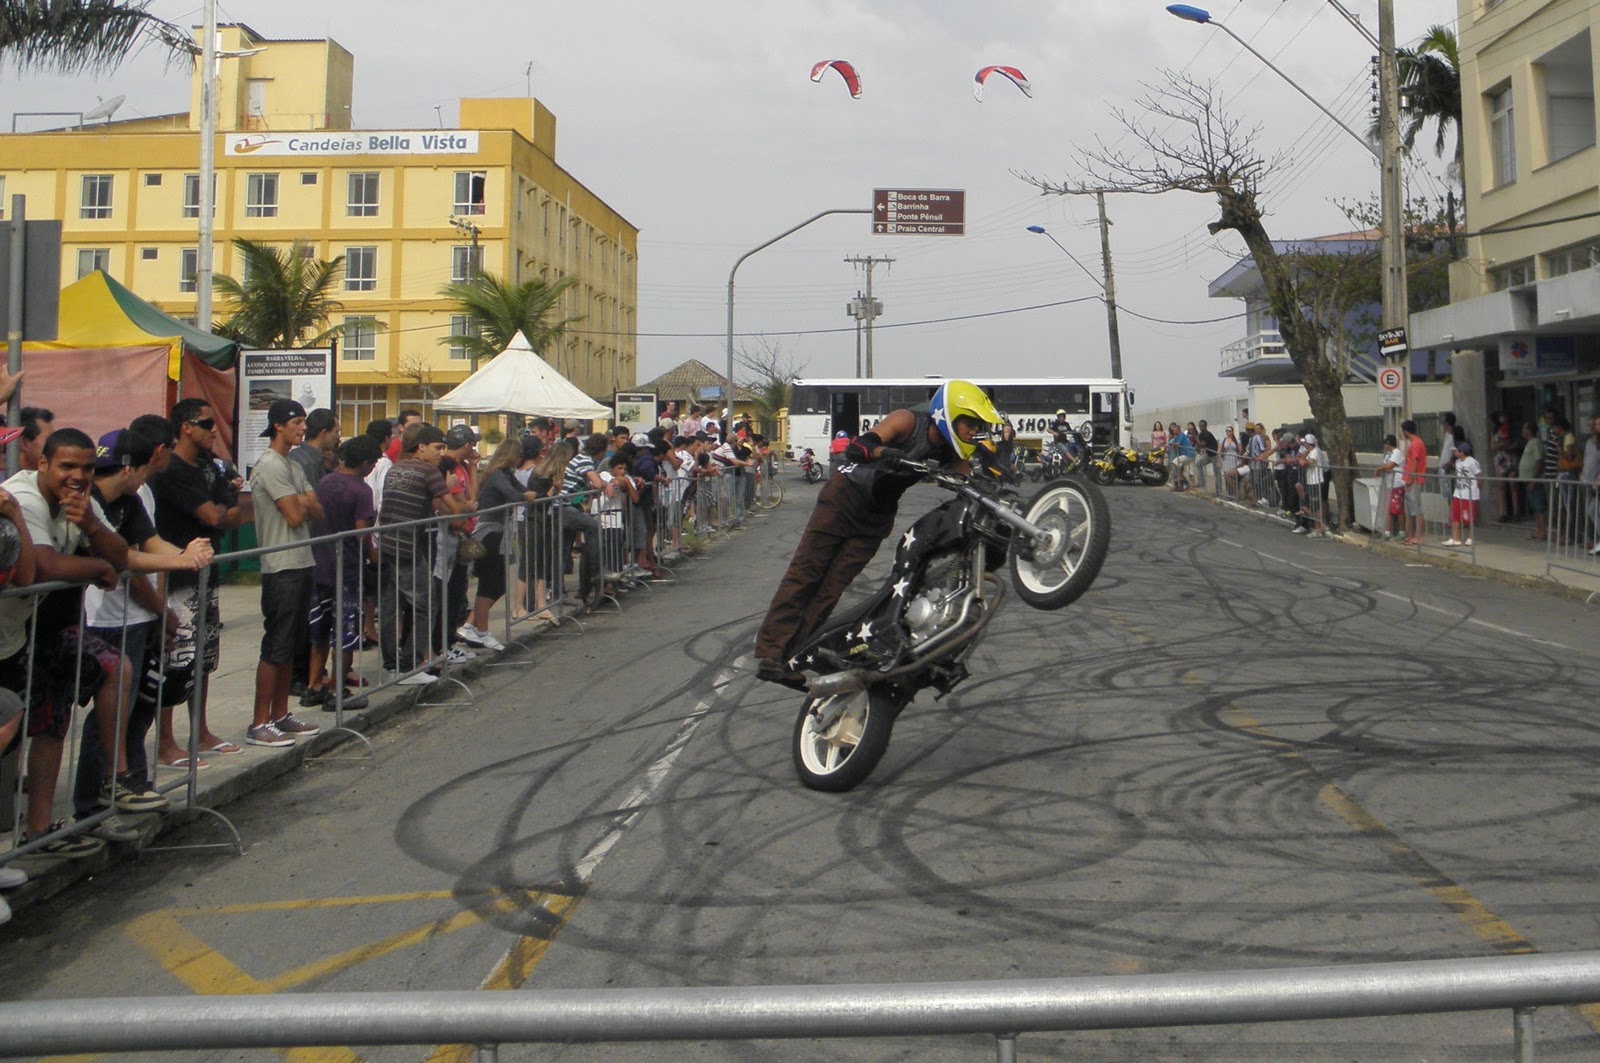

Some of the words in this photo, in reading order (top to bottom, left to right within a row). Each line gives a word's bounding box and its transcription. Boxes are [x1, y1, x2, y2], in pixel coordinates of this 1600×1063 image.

[288, 138, 363, 151] Candeias
[368, 135, 410, 150] Bella
[422, 134, 467, 149] Vista
[897, 193, 916, 201] Boca
[918, 193, 928, 201] da
[929, 193, 950, 201] Barra
[897, 202, 929, 210] Barrinha
[897, 212, 919, 220] Ponte
[917, 225, 945, 233] Central
[1386, 374, 1394, 384] E
